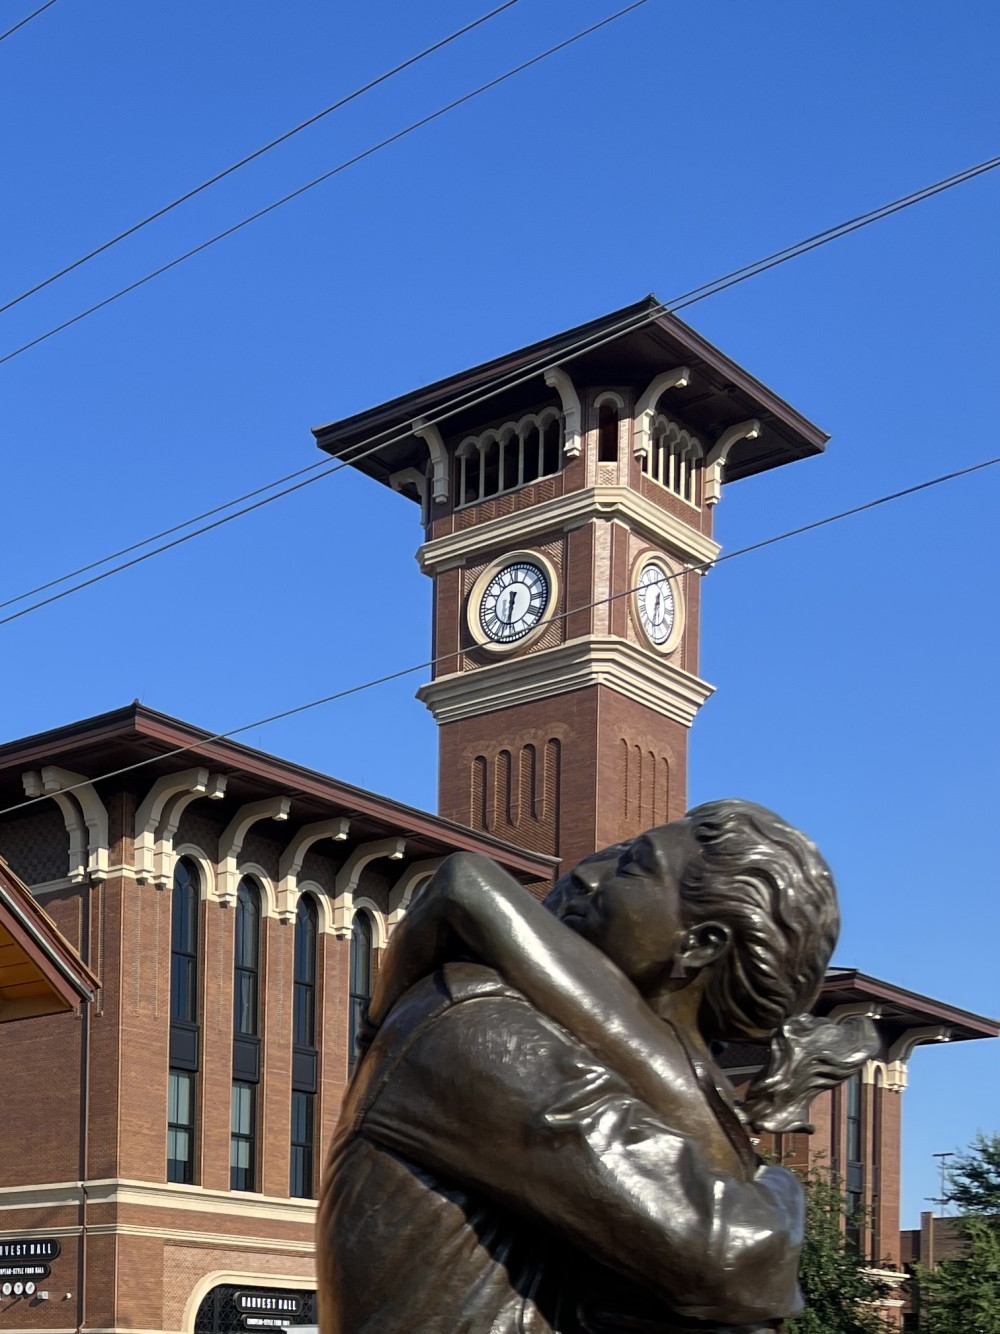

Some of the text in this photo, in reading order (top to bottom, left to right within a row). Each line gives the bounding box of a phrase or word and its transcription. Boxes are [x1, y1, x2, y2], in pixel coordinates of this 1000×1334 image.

[30, 1243, 52, 1255] HALL
[241, 1296, 297, 1311] HARVEST HALL
